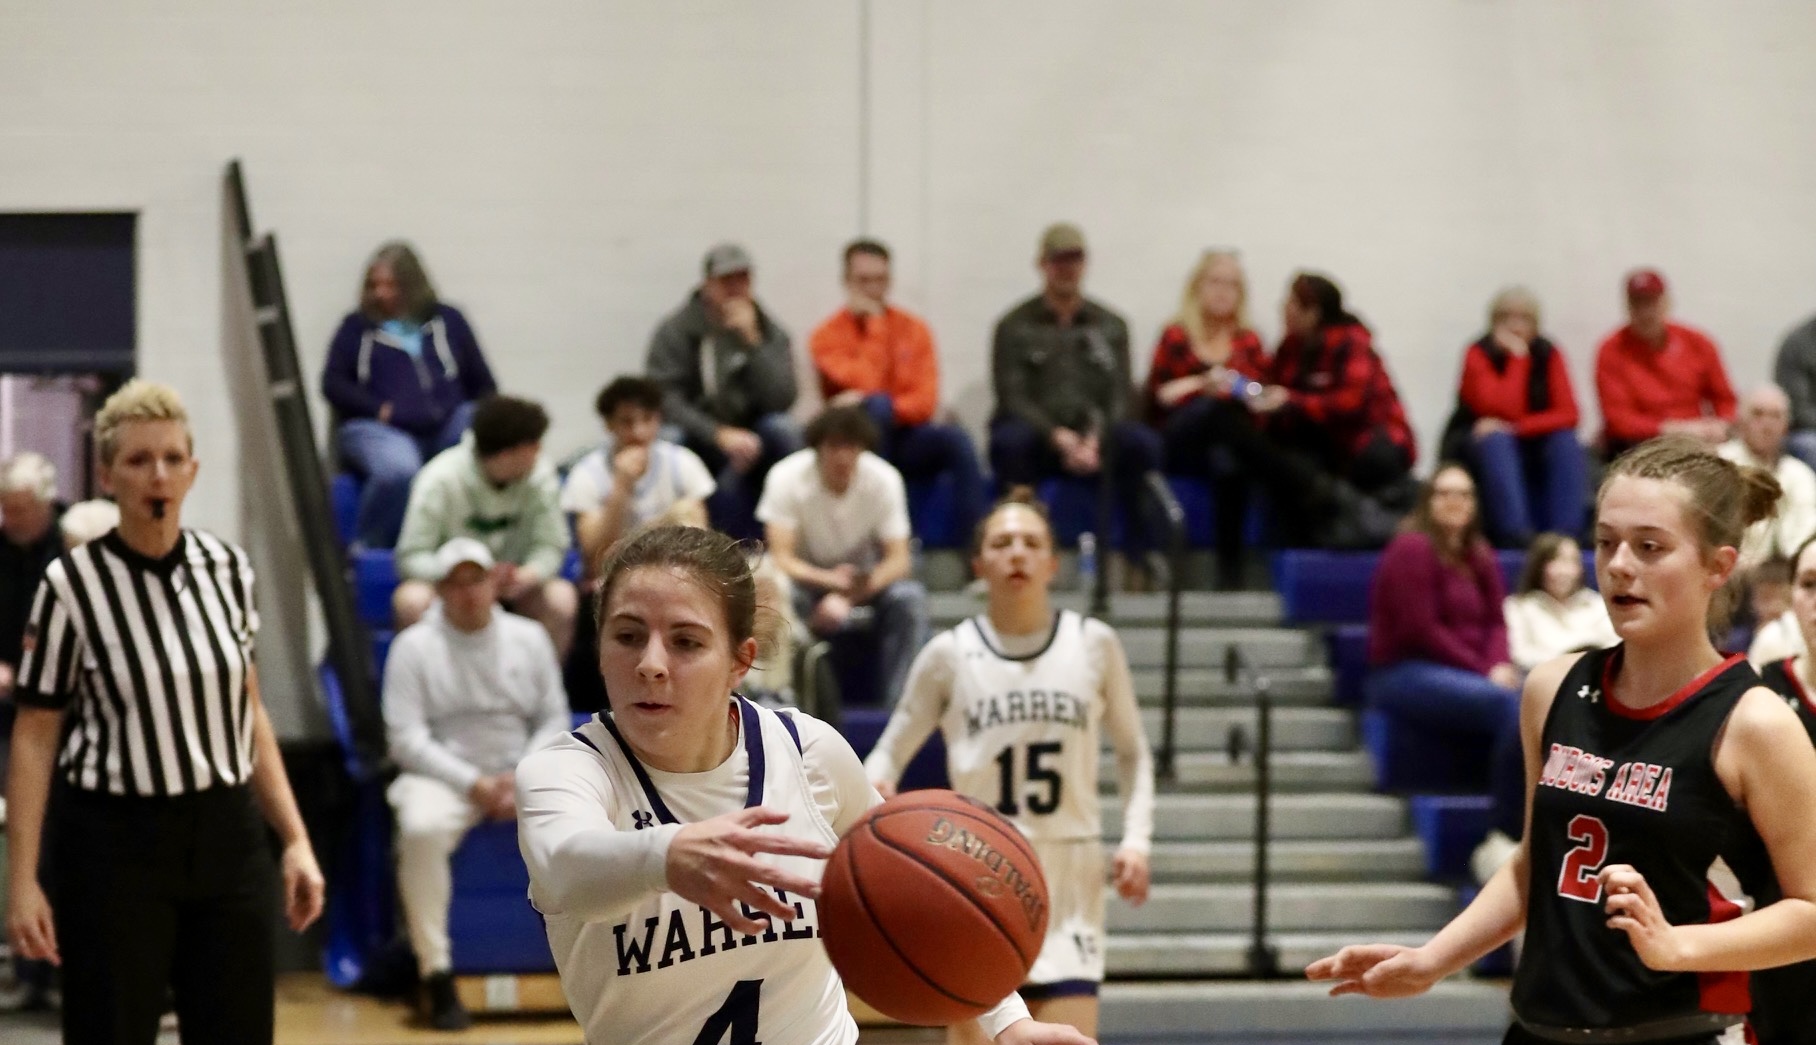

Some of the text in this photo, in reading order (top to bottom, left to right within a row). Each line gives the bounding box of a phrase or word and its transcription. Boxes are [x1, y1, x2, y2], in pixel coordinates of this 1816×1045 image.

[964, 690, 1090, 736] WARREN
[995, 741, 1063, 815] 15
[1605, 762, 1674, 812] AREA
[926, 816, 1045, 934] SPALDING
[1557, 814, 1609, 904] 2
